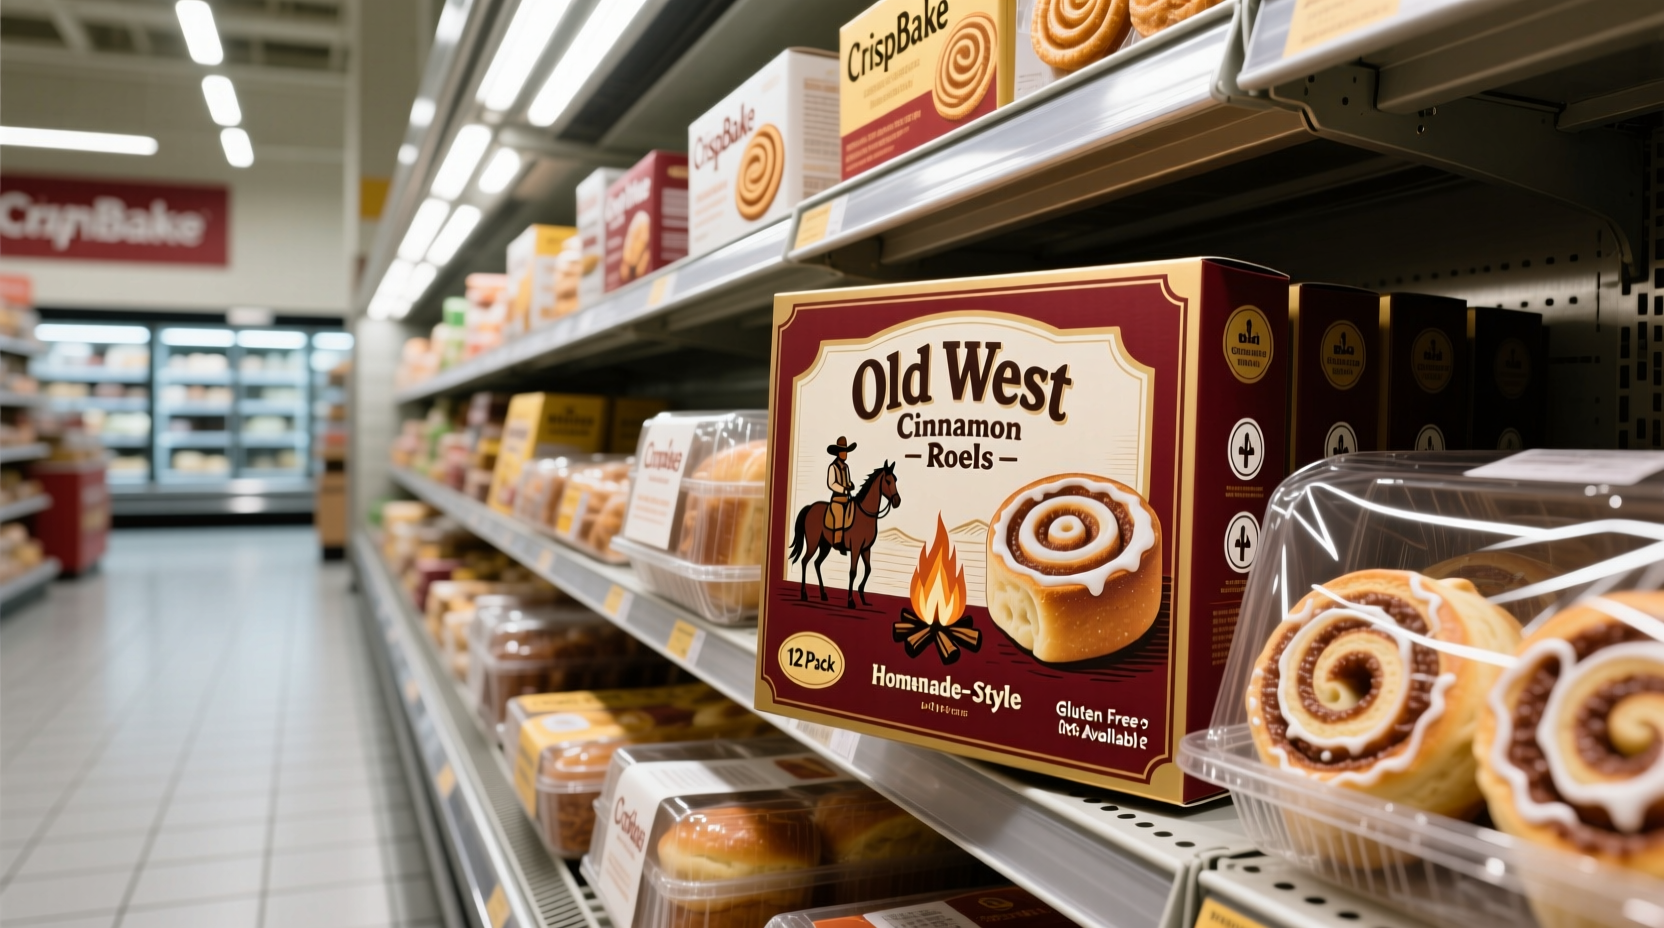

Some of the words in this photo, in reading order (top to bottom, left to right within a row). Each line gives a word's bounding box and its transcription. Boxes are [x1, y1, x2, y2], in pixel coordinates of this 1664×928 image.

[848, 0, 949, 82] CrispBake
[852, 343, 933, 421] Old
[943, 341, 1073, 423] West
[897, 412, 1022, 440] Cinnamon
[926, 442, 993, 470] Roels
[787, 647, 804, 668] 12
[805, 650, 836, 673] Pack
[1056, 700, 1103, 723] Gluten
